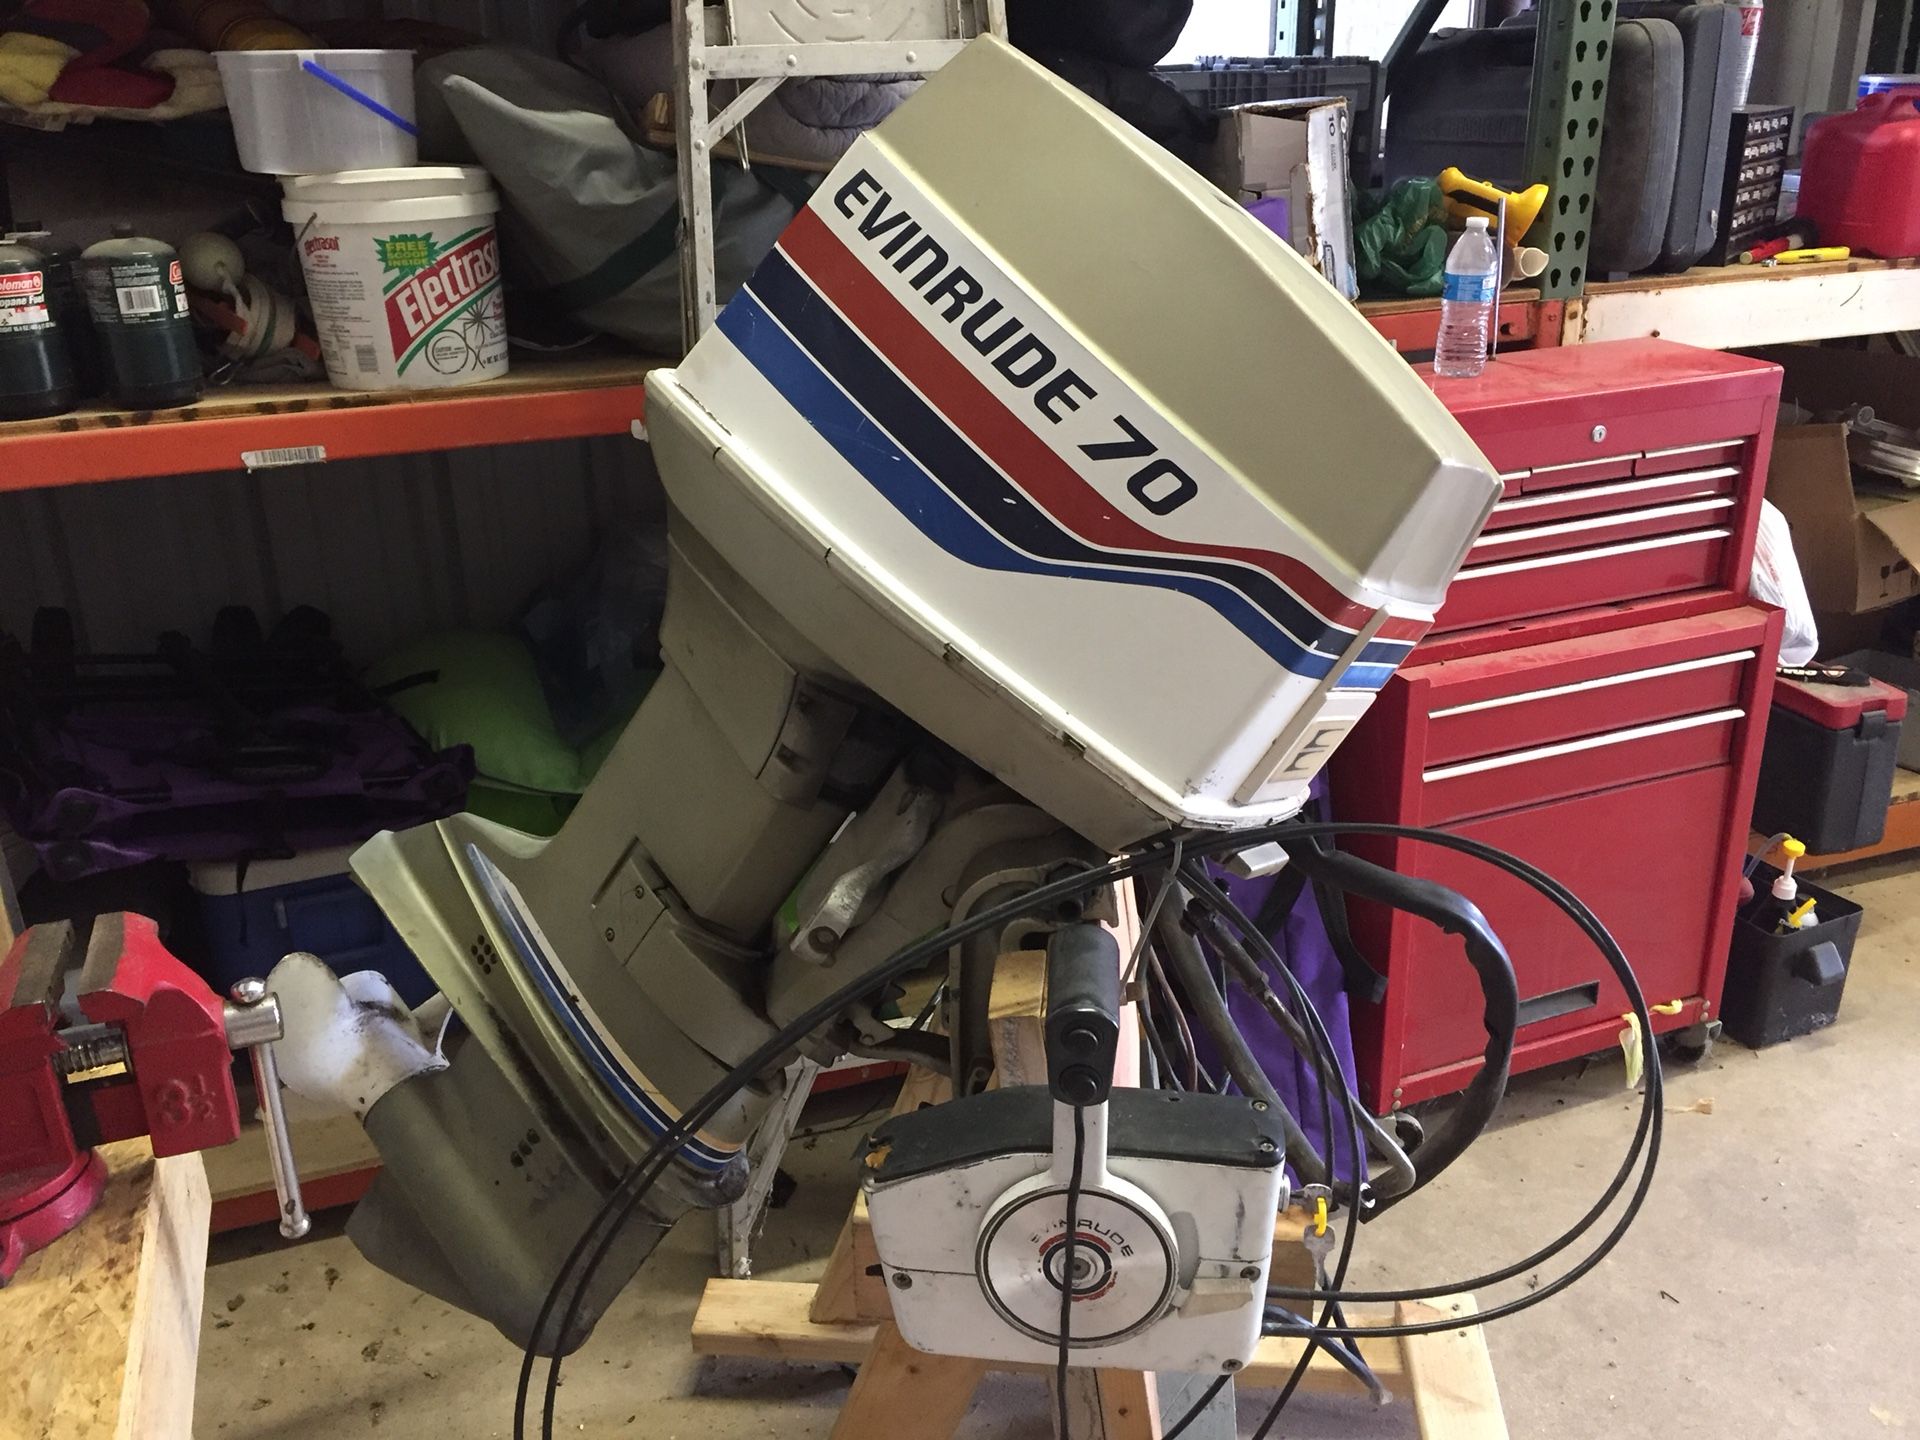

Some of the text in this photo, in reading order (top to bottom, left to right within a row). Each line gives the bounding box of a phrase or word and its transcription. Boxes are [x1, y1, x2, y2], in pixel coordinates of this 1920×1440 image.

[385, 241, 428, 251] FREE
[0, 278, 33, 290] oleman
[395, 239, 499, 338] Electraso
[0, 297, 27, 308] opane
[834, 169, 1199, 516] EVINRUDE 70
